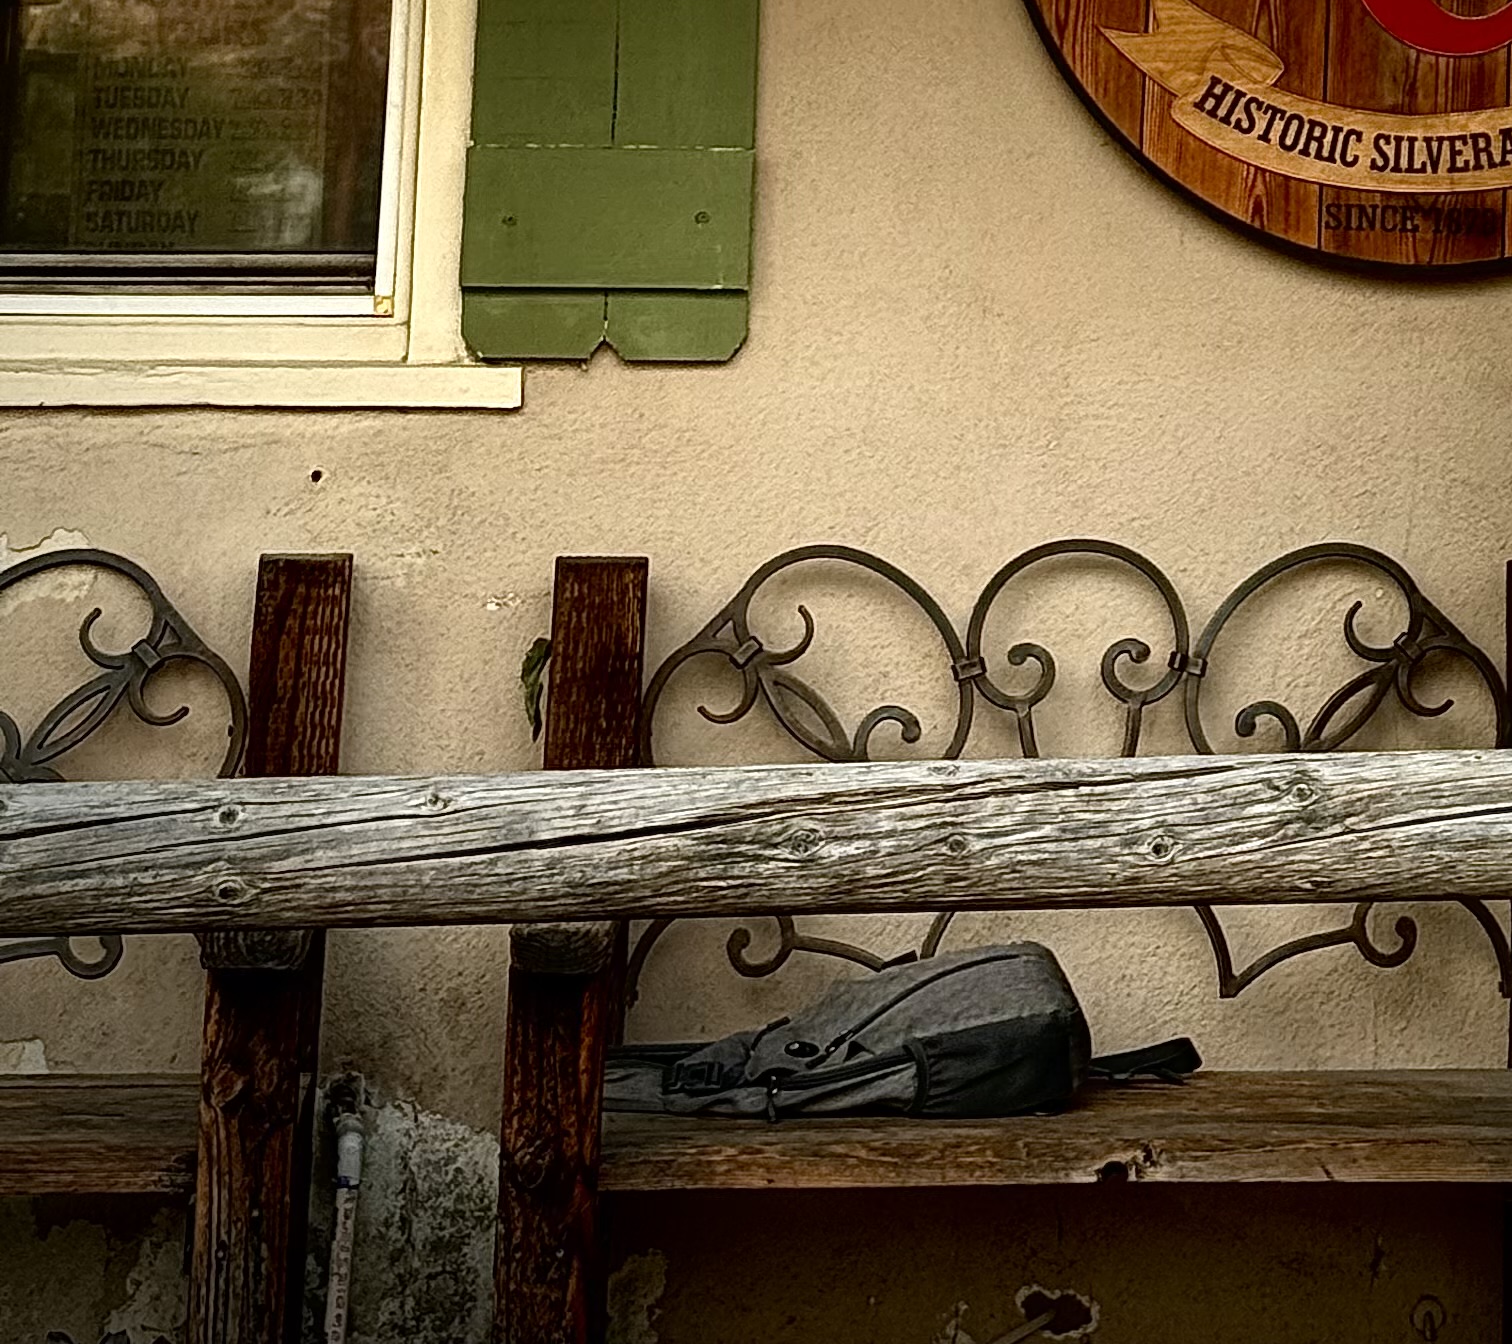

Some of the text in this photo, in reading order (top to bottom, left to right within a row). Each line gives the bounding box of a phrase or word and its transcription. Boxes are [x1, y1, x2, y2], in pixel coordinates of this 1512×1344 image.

[92, 86, 191, 110] TUESDAY
[90, 117, 225, 141] WEDNESDAY
[1193, 75, 1361, 168] HISTORIC
[88, 149, 205, 172] THURSDAY
[85, 180, 166, 203] FRIDAY
[84, 210, 200, 235] SATURDAY
[1325, 203, 1420, 233] SINCE
